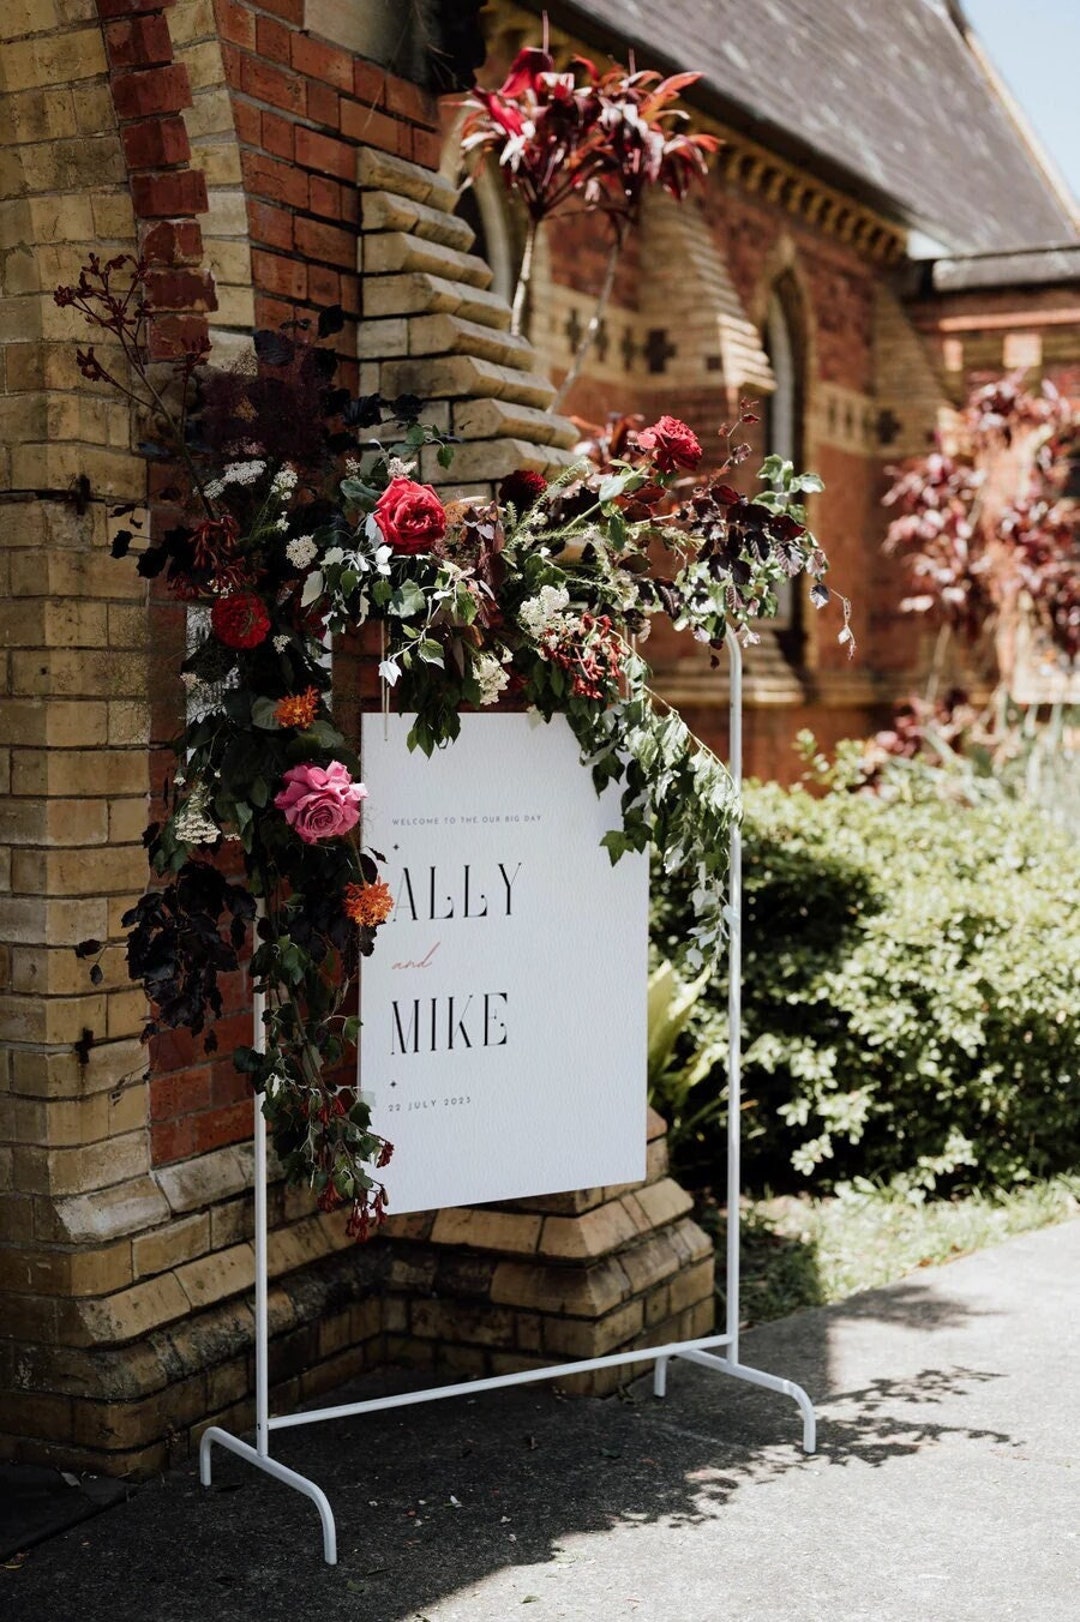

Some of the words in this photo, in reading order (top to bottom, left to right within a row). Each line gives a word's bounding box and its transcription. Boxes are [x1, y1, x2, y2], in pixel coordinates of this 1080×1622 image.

[392, 817, 439, 826] WELCOME
[444, 816, 456, 825] TO
[460, 815, 478, 824] THE
[482, 815, 500, 823] OUR
[505, 815, 520, 823] BIG
[524, 814, 542, 822] DAY
[392, 862, 522, 922] ALLY
[392, 941, 441, 970] and
[391, 992, 508, 1055] MIKE
[388, 1104, 401, 1112] 22
[408, 1099, 437, 1111] JULY
